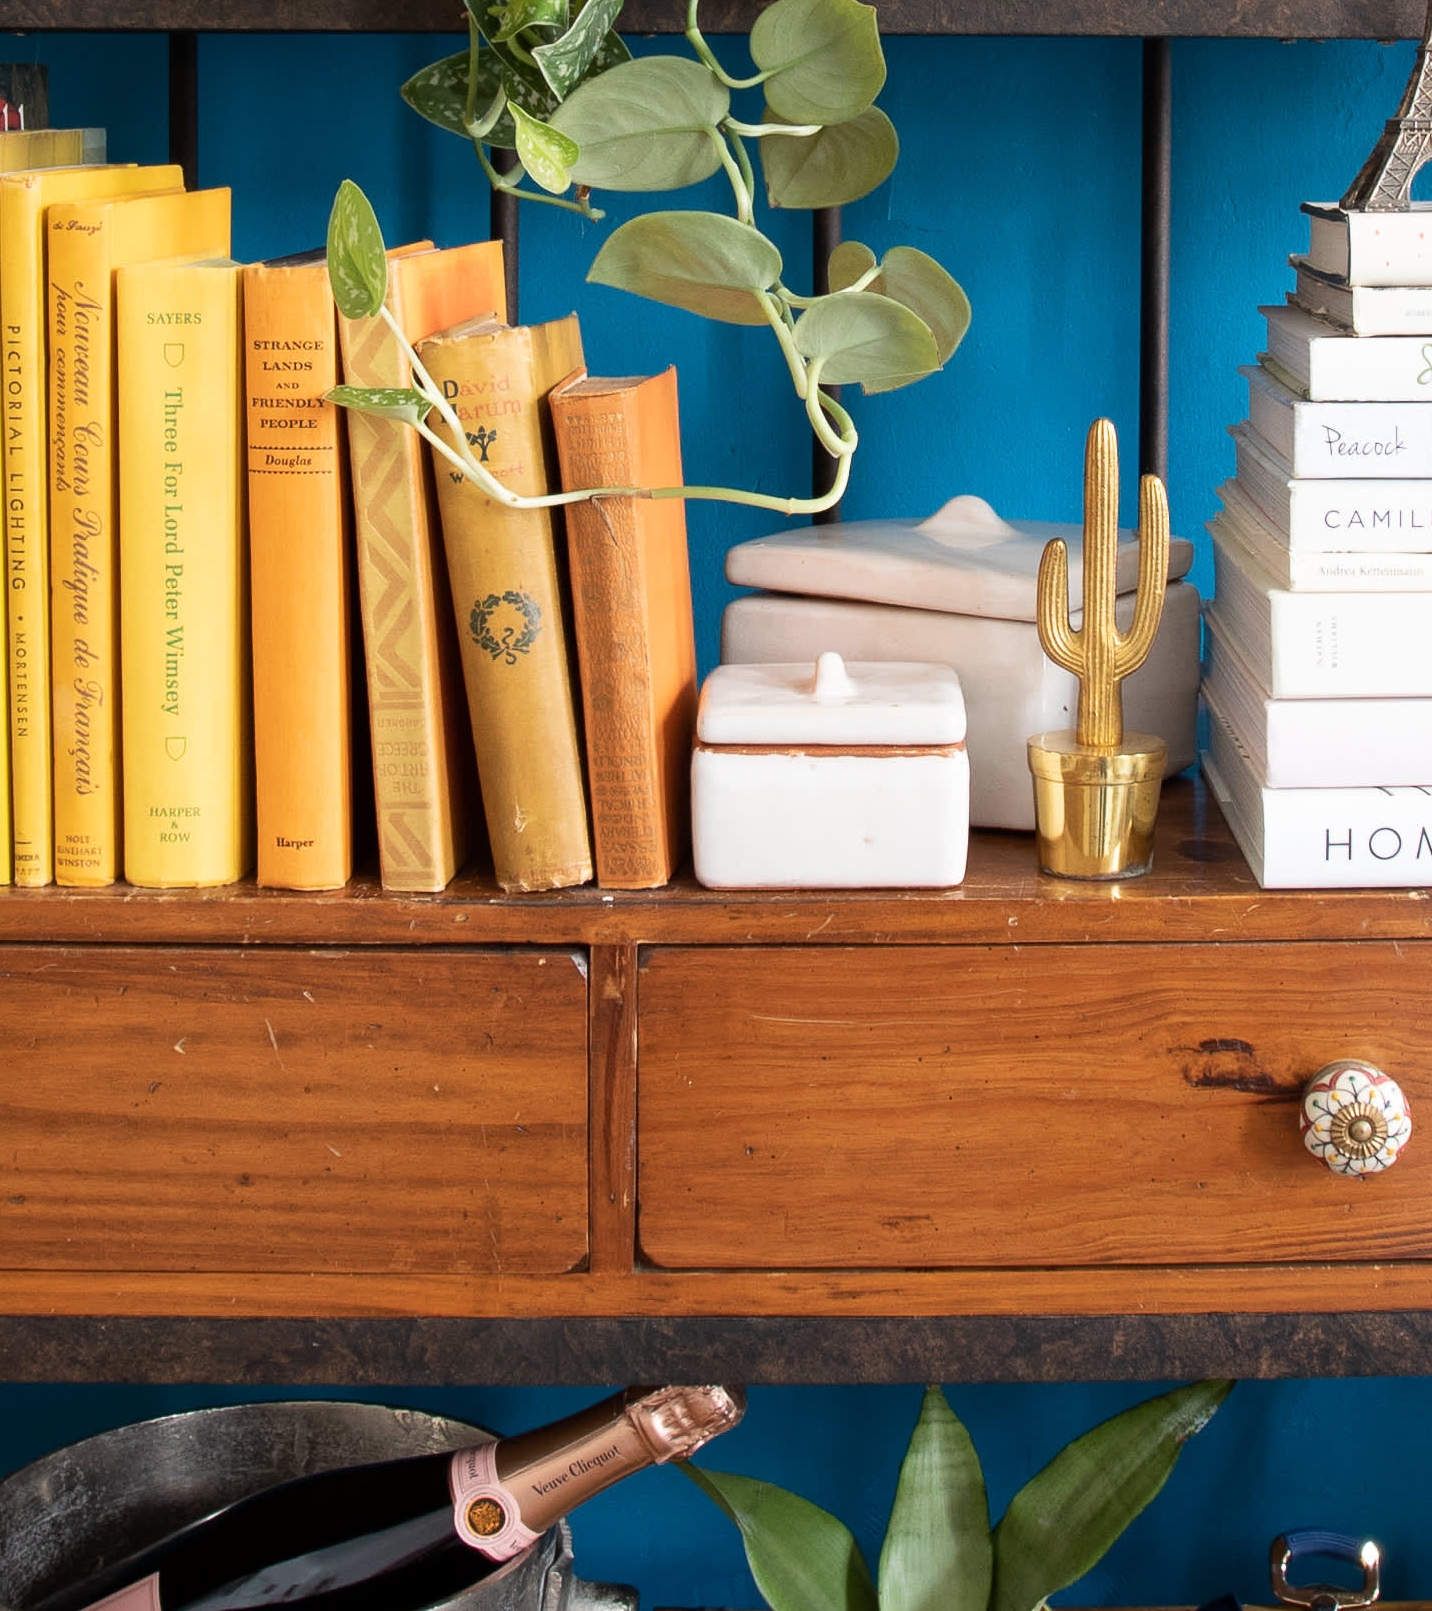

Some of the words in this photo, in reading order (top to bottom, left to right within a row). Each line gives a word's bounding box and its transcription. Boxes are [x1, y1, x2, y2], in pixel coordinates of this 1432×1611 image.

[146, 312, 203, 325] SAYERS
[253, 340, 325, 351] STRANGE
[262, 360, 313, 371] LANDS
[7, 325, 24, 456] PICTORIAL
[275, 382, 299, 390] AND
[442, 374, 511, 400] David
[251, 397, 327, 410] FRIENDLY
[164, 386, 184, 453] Three
[260, 418, 318, 430] PEOPLE
[1321, 424, 1409, 457] Peacock
[264, 454, 313, 468] Douglas
[164, 461, 184, 497] For
[10, 473, 26, 590] LIGHTING
[164, 504, 185, 555] Lord
[164, 563, 185, 620] Peter
[161, 625, 186, 717] Wimsey
[16, 633, 28, 738] MORTENSEN
[149, 806, 201, 818] HARPER
[159, 832, 192, 844] ROW
[276, 837, 315, 851] Harper
[531, 1470, 570, 1498] Veuve
[568, 1444, 622, 1479] Clicquot
